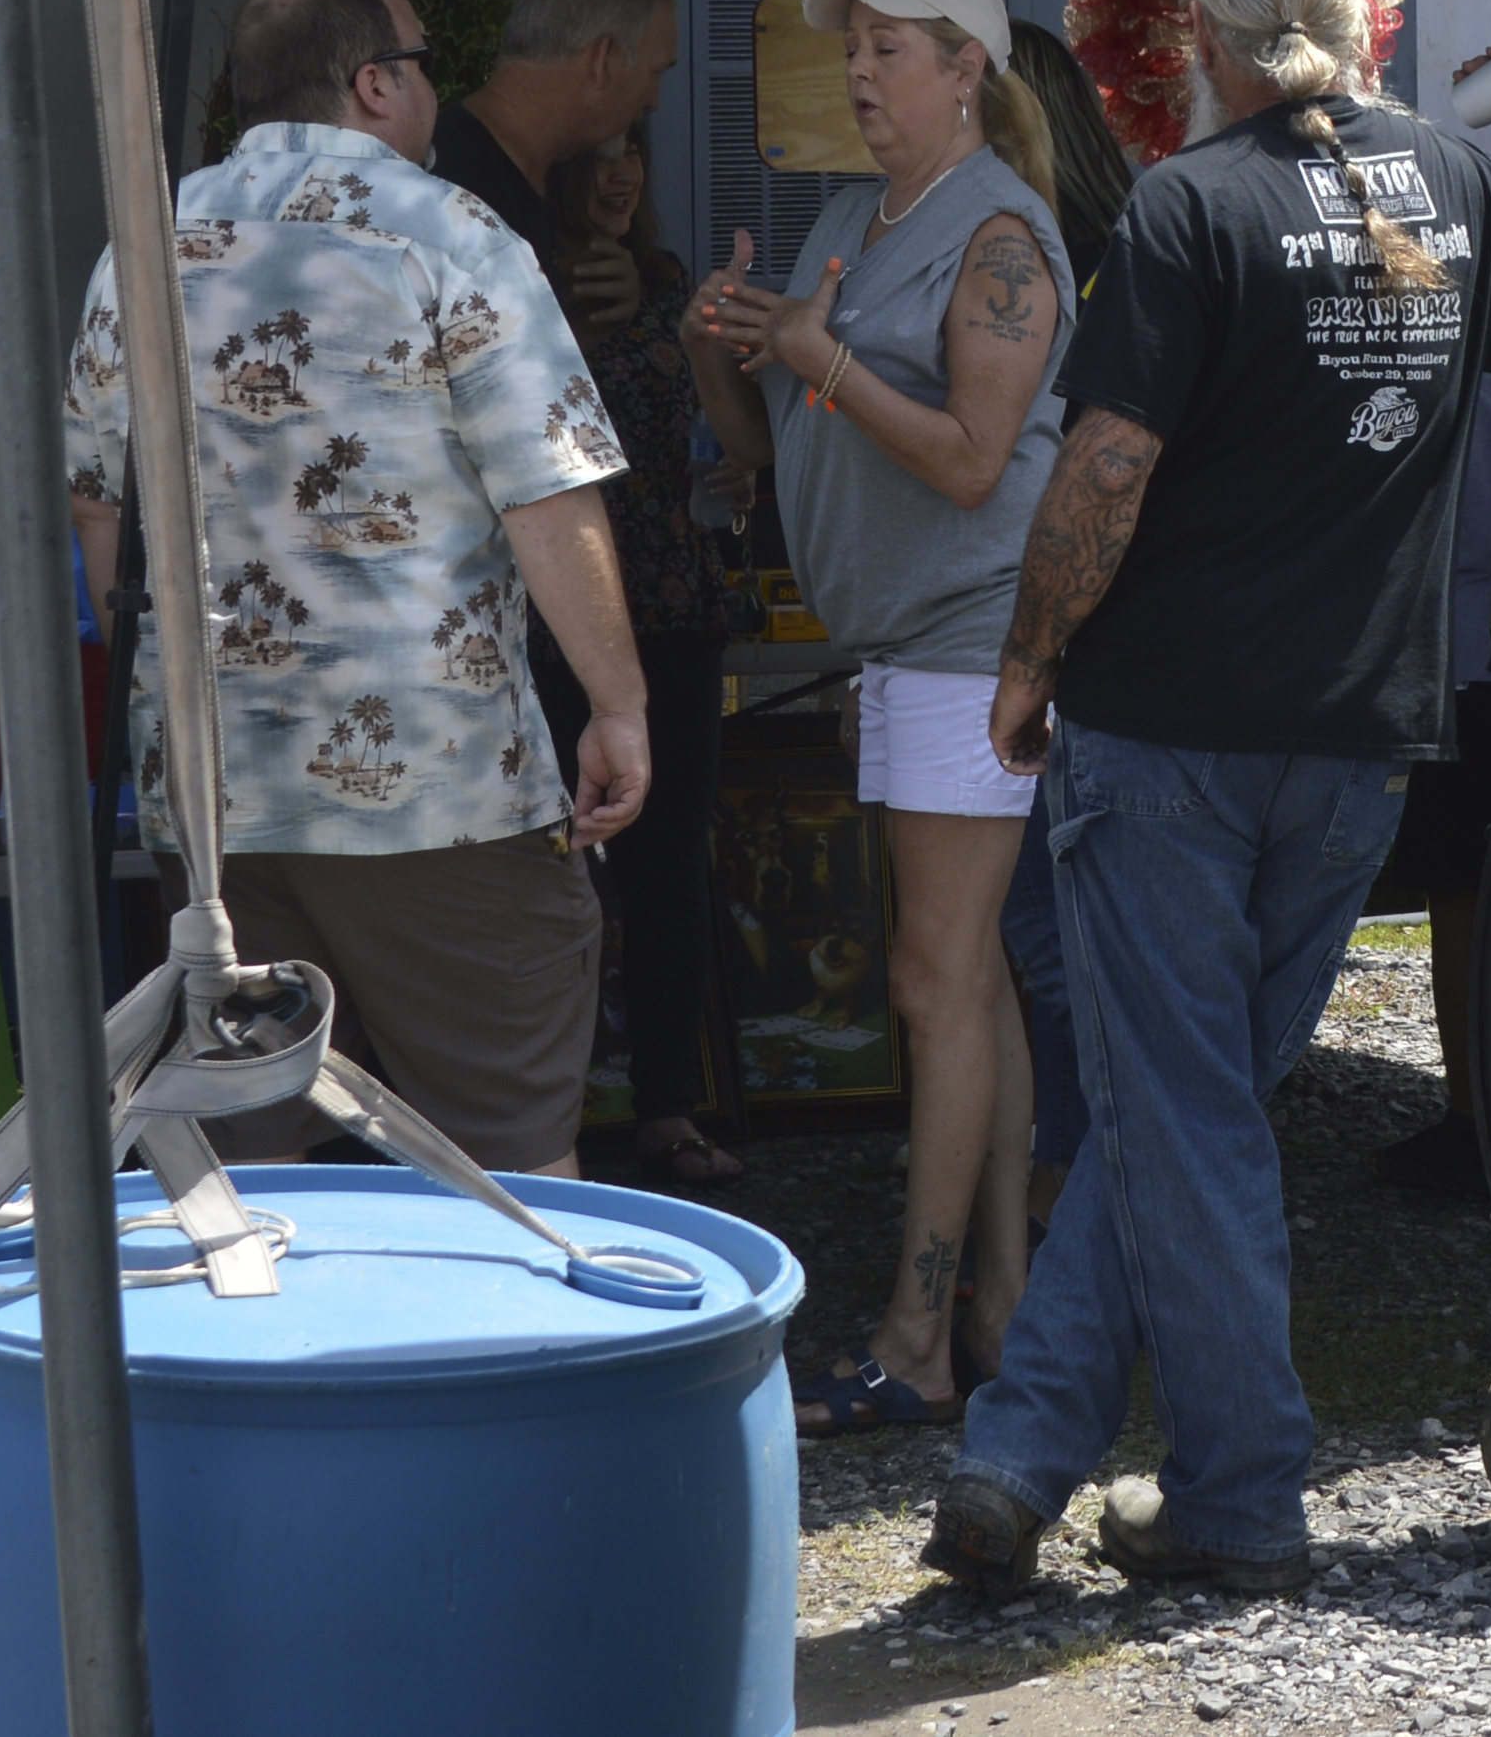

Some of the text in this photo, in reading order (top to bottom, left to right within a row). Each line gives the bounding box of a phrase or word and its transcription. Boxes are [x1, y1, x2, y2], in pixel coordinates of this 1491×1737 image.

[1307, 291, 1462, 327] BACK IN BLACK
[1306, 330, 1330, 344] THE
[1335, 330, 1360, 344] TRUE
[1401, 325, 1462, 343] EXPERIENCE
[1362, 353, 1393, 365] Rum
[1395, 353, 1450, 366] Distillery
[1384, 369, 1404, 381] 29,
[1405, 370, 1432, 381] 2016
[1347, 401, 1416, 443] Bayou
